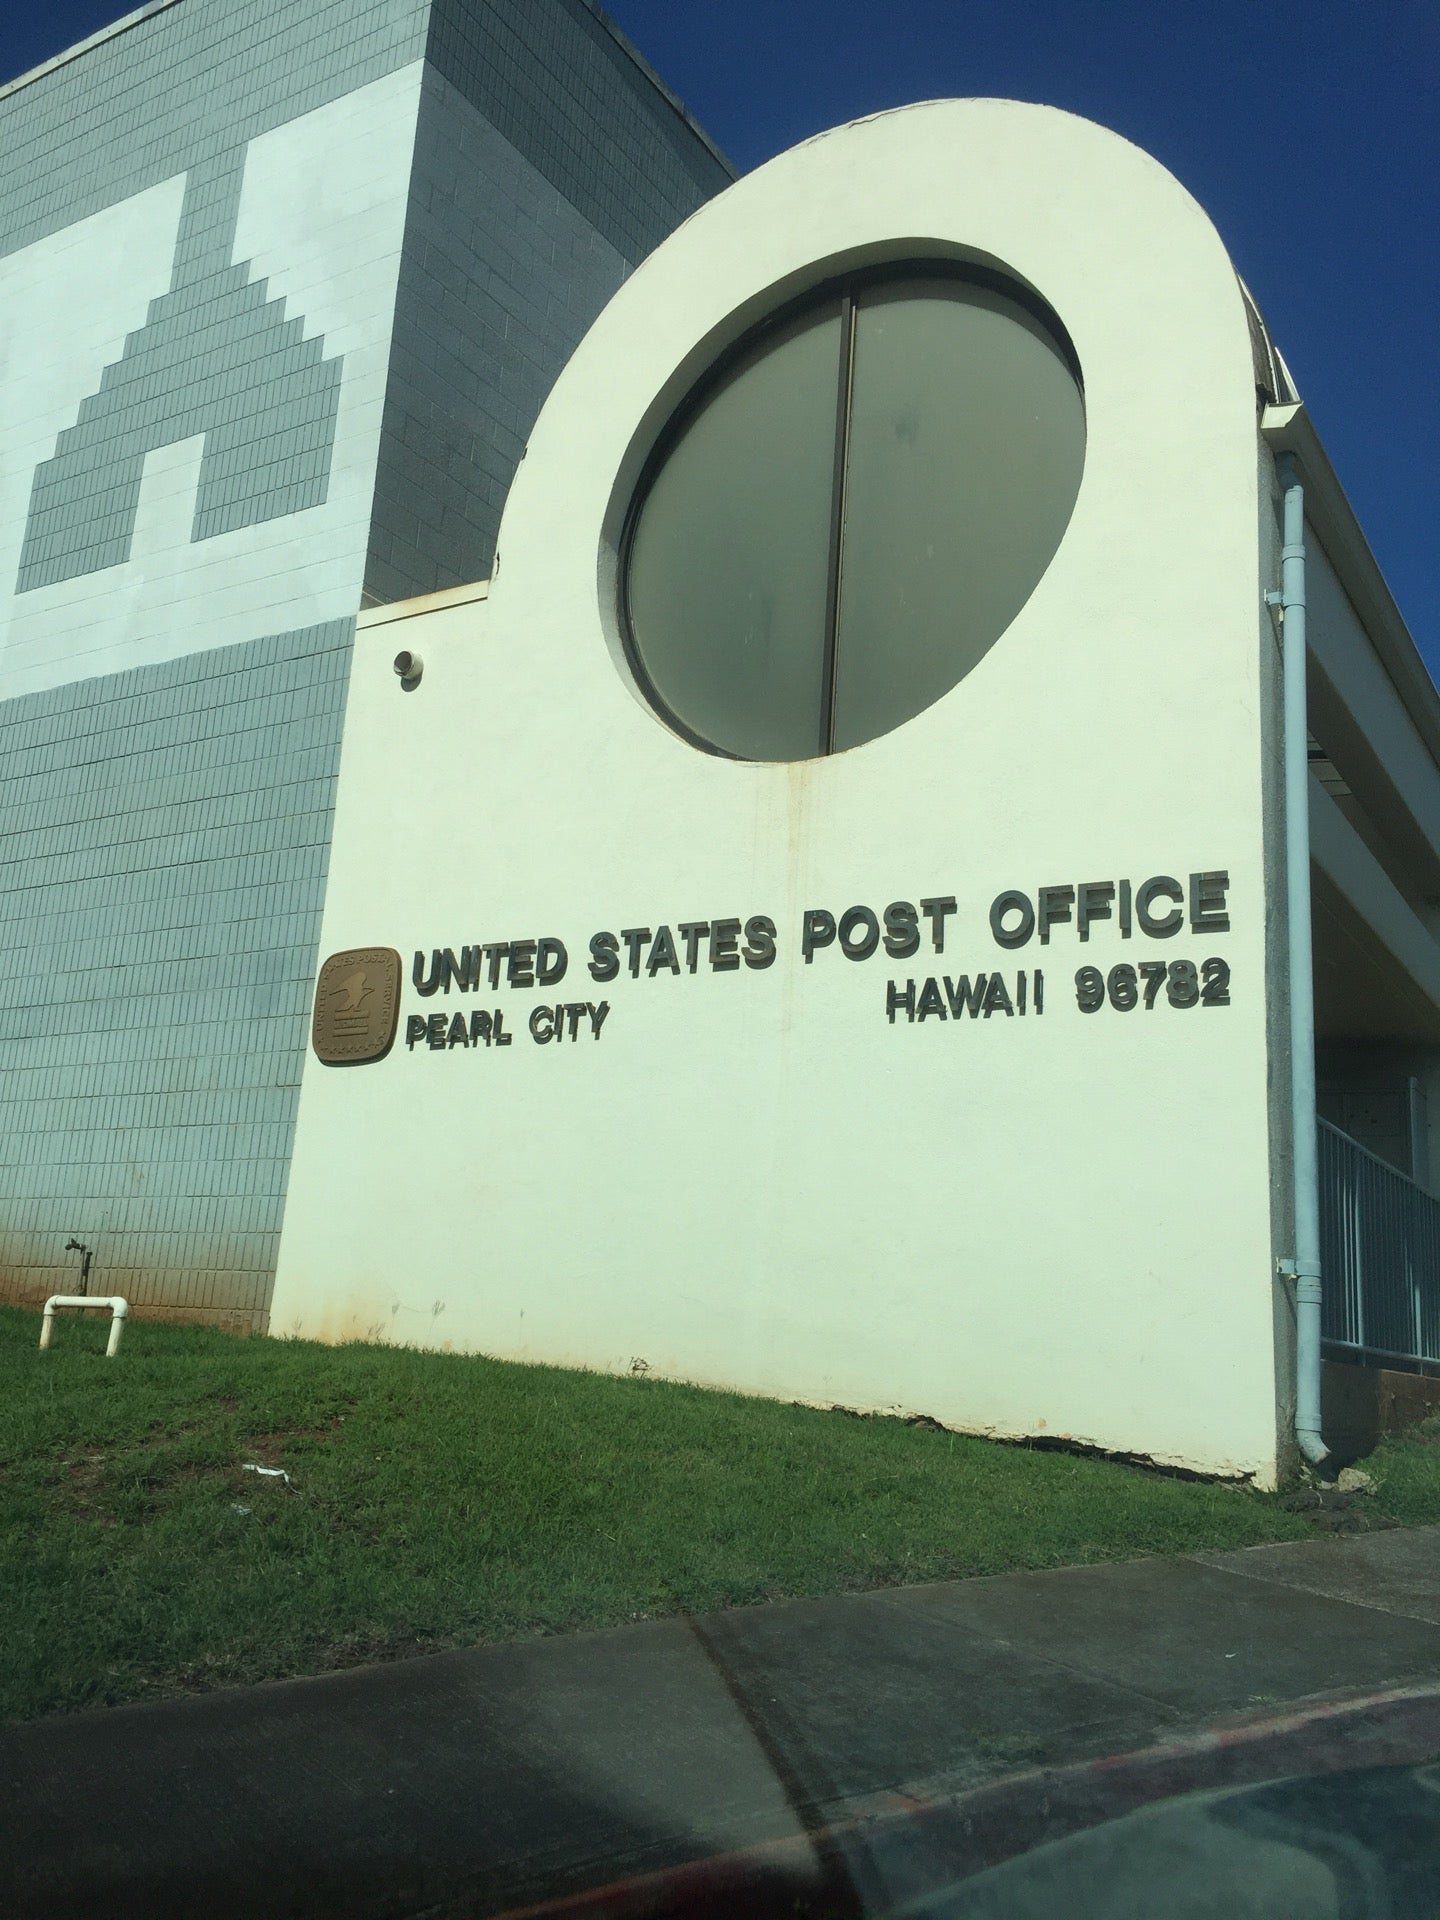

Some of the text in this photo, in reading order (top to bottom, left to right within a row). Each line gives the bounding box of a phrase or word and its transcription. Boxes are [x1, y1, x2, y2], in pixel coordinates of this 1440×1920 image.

[413, 871, 1230, 997] UNITED STATES POST OFFICE
[886, 958, 1230, 1023] HAWAII 96782
[406, 1001, 610, 1051] PEARL CITY
